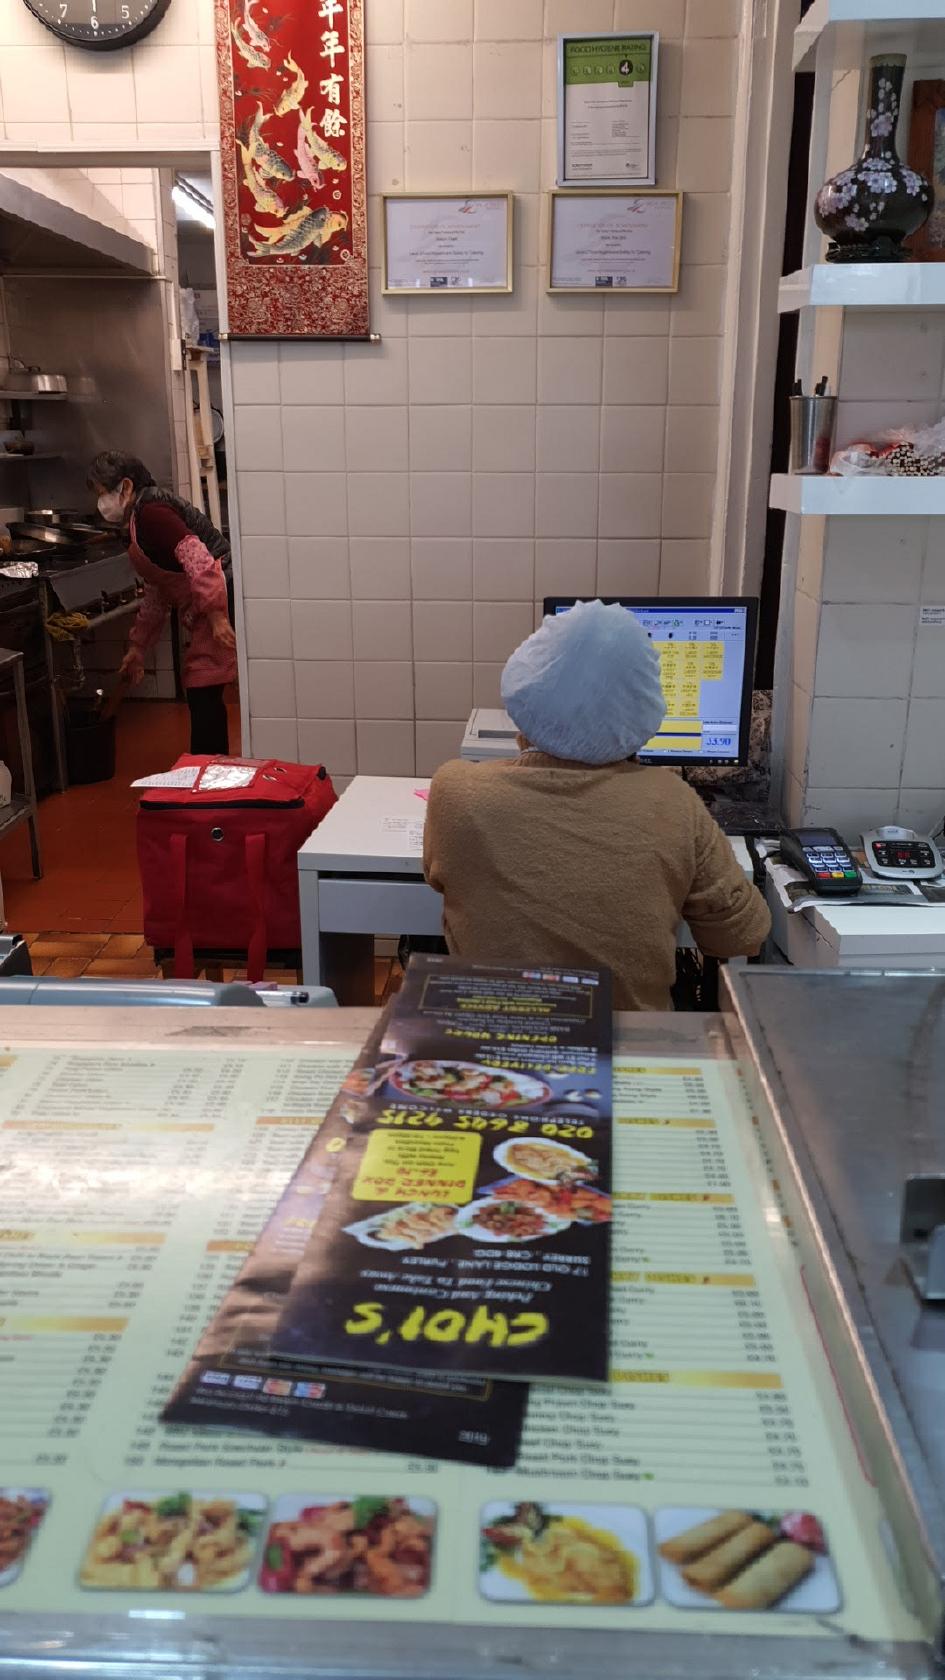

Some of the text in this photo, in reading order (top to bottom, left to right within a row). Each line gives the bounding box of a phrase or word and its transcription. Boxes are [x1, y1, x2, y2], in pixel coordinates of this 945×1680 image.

[59, 4, 68, 18] 7
[121, 5, 130, 18] 5
[90, 16, 99, 29] 6
[621, 61, 629, 74] 4
[541, 1123, 593, 1139] 020
[402, 1179, 466, 1188] DINNER
[395, 1188, 450, 1198] LUNCH
[402, 1257, 447, 1268] PURLEY
[458, 1260, 490, 1270] LANE
[494, 1261, 539, 1271] LODGE
[543, 1263, 571, 1273] OLD
[458, 1278, 493, 1288] Food
[496, 1279, 552, 1292] Chinese
[374, 1284, 449, 1300] Cantonese
[485, 1291, 533, 1304] Peking
[345, 1302, 549, 1347] CHOI'S
